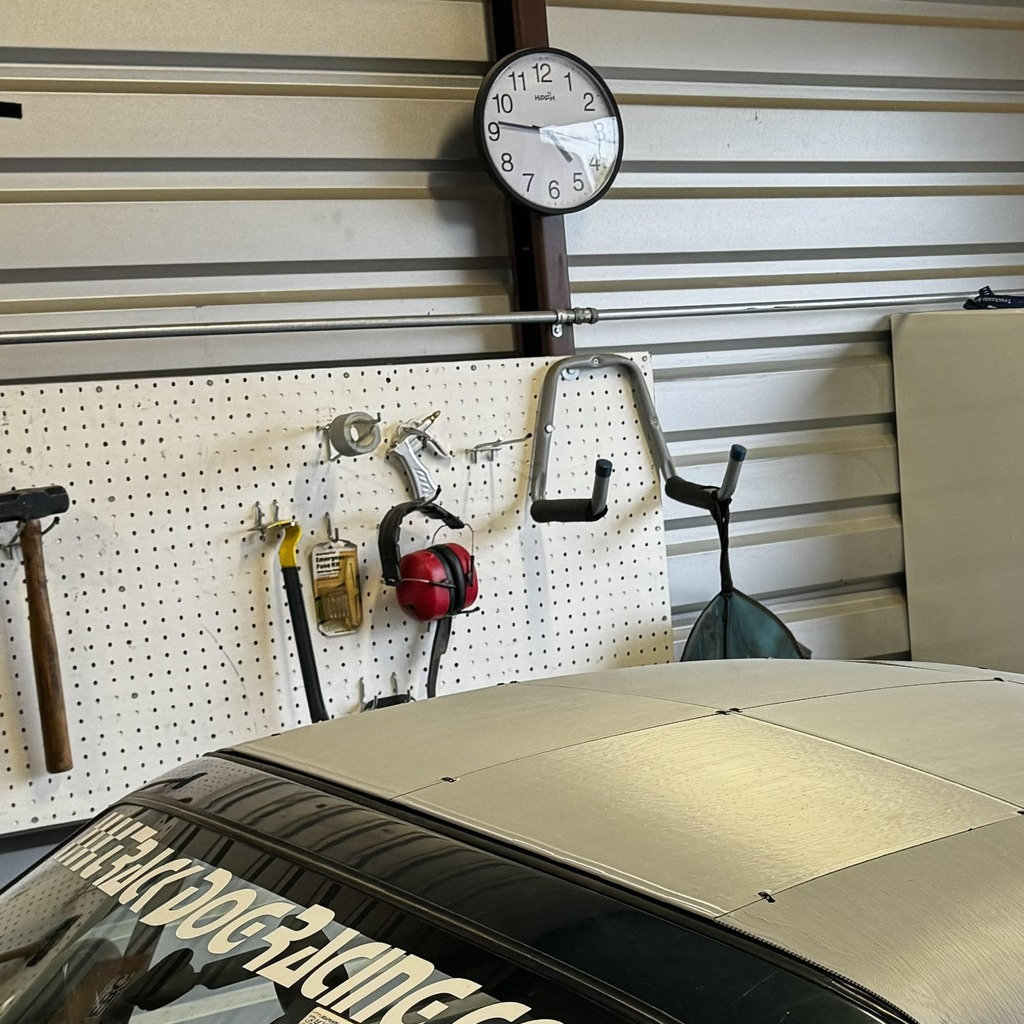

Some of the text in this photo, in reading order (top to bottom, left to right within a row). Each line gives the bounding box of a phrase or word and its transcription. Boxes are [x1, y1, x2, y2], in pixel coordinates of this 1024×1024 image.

[508, 71, 526, 91] 11
[532, 63, 552, 83] 12
[564, 72, 572, 91] 1
[492, 93, 513, 114] 10
[583, 92, 595, 111] 2
[488, 121, 500, 141] 9
[595, 121, 606, 141] 3
[501, 153, 514, 172] 8
[589, 152, 601, 171] 4
[522, 173, 535, 192] 7
[548, 180, 560, 199] 6
[573, 172, 584, 191] 5
